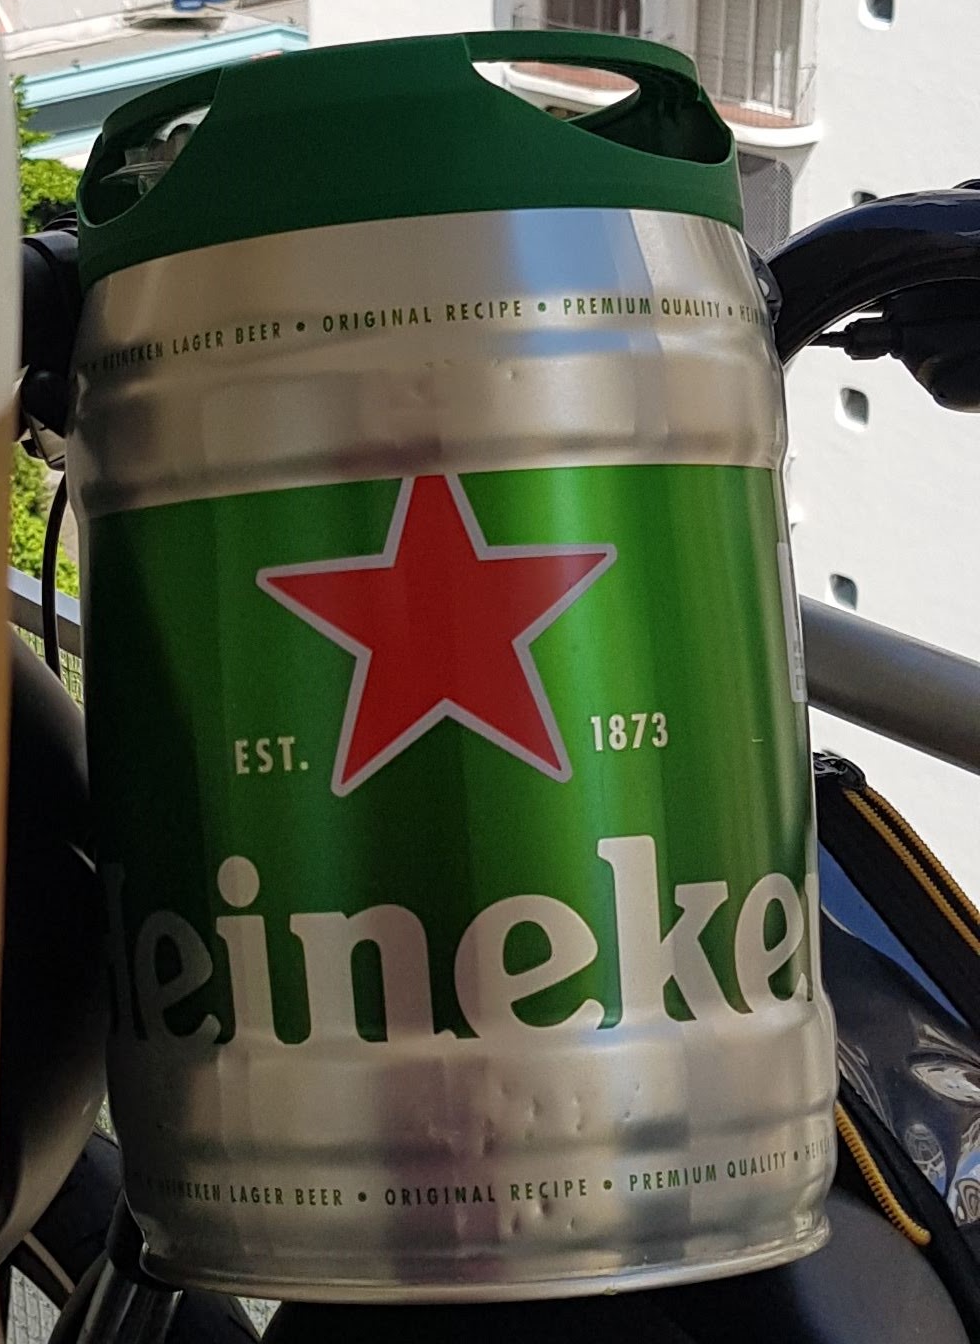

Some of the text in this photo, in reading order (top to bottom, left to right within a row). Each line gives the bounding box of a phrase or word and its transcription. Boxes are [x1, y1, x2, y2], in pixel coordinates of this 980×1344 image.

[173, 331, 224, 355] LAGER
[235, 322, 282, 346] BEER
[322, 306, 432, 333] ORIGINAL
[446, 300, 522, 321] RECIPE
[563, 297, 652, 315] PREMIUM
[661, 298, 720, 318] QUALITY
[234, 712, 669, 774] EST. 1873
[229, 1184, 284, 1205] LAGER
[295, 1187, 344, 1207] BEER
[384, 1184, 496, 1206] ORIGINAL
[510, 1178, 588, 1201] RECIPE
[629, 1163, 718, 1192] PREMIUM
[727, 1151, 788, 1179] QUALITY
